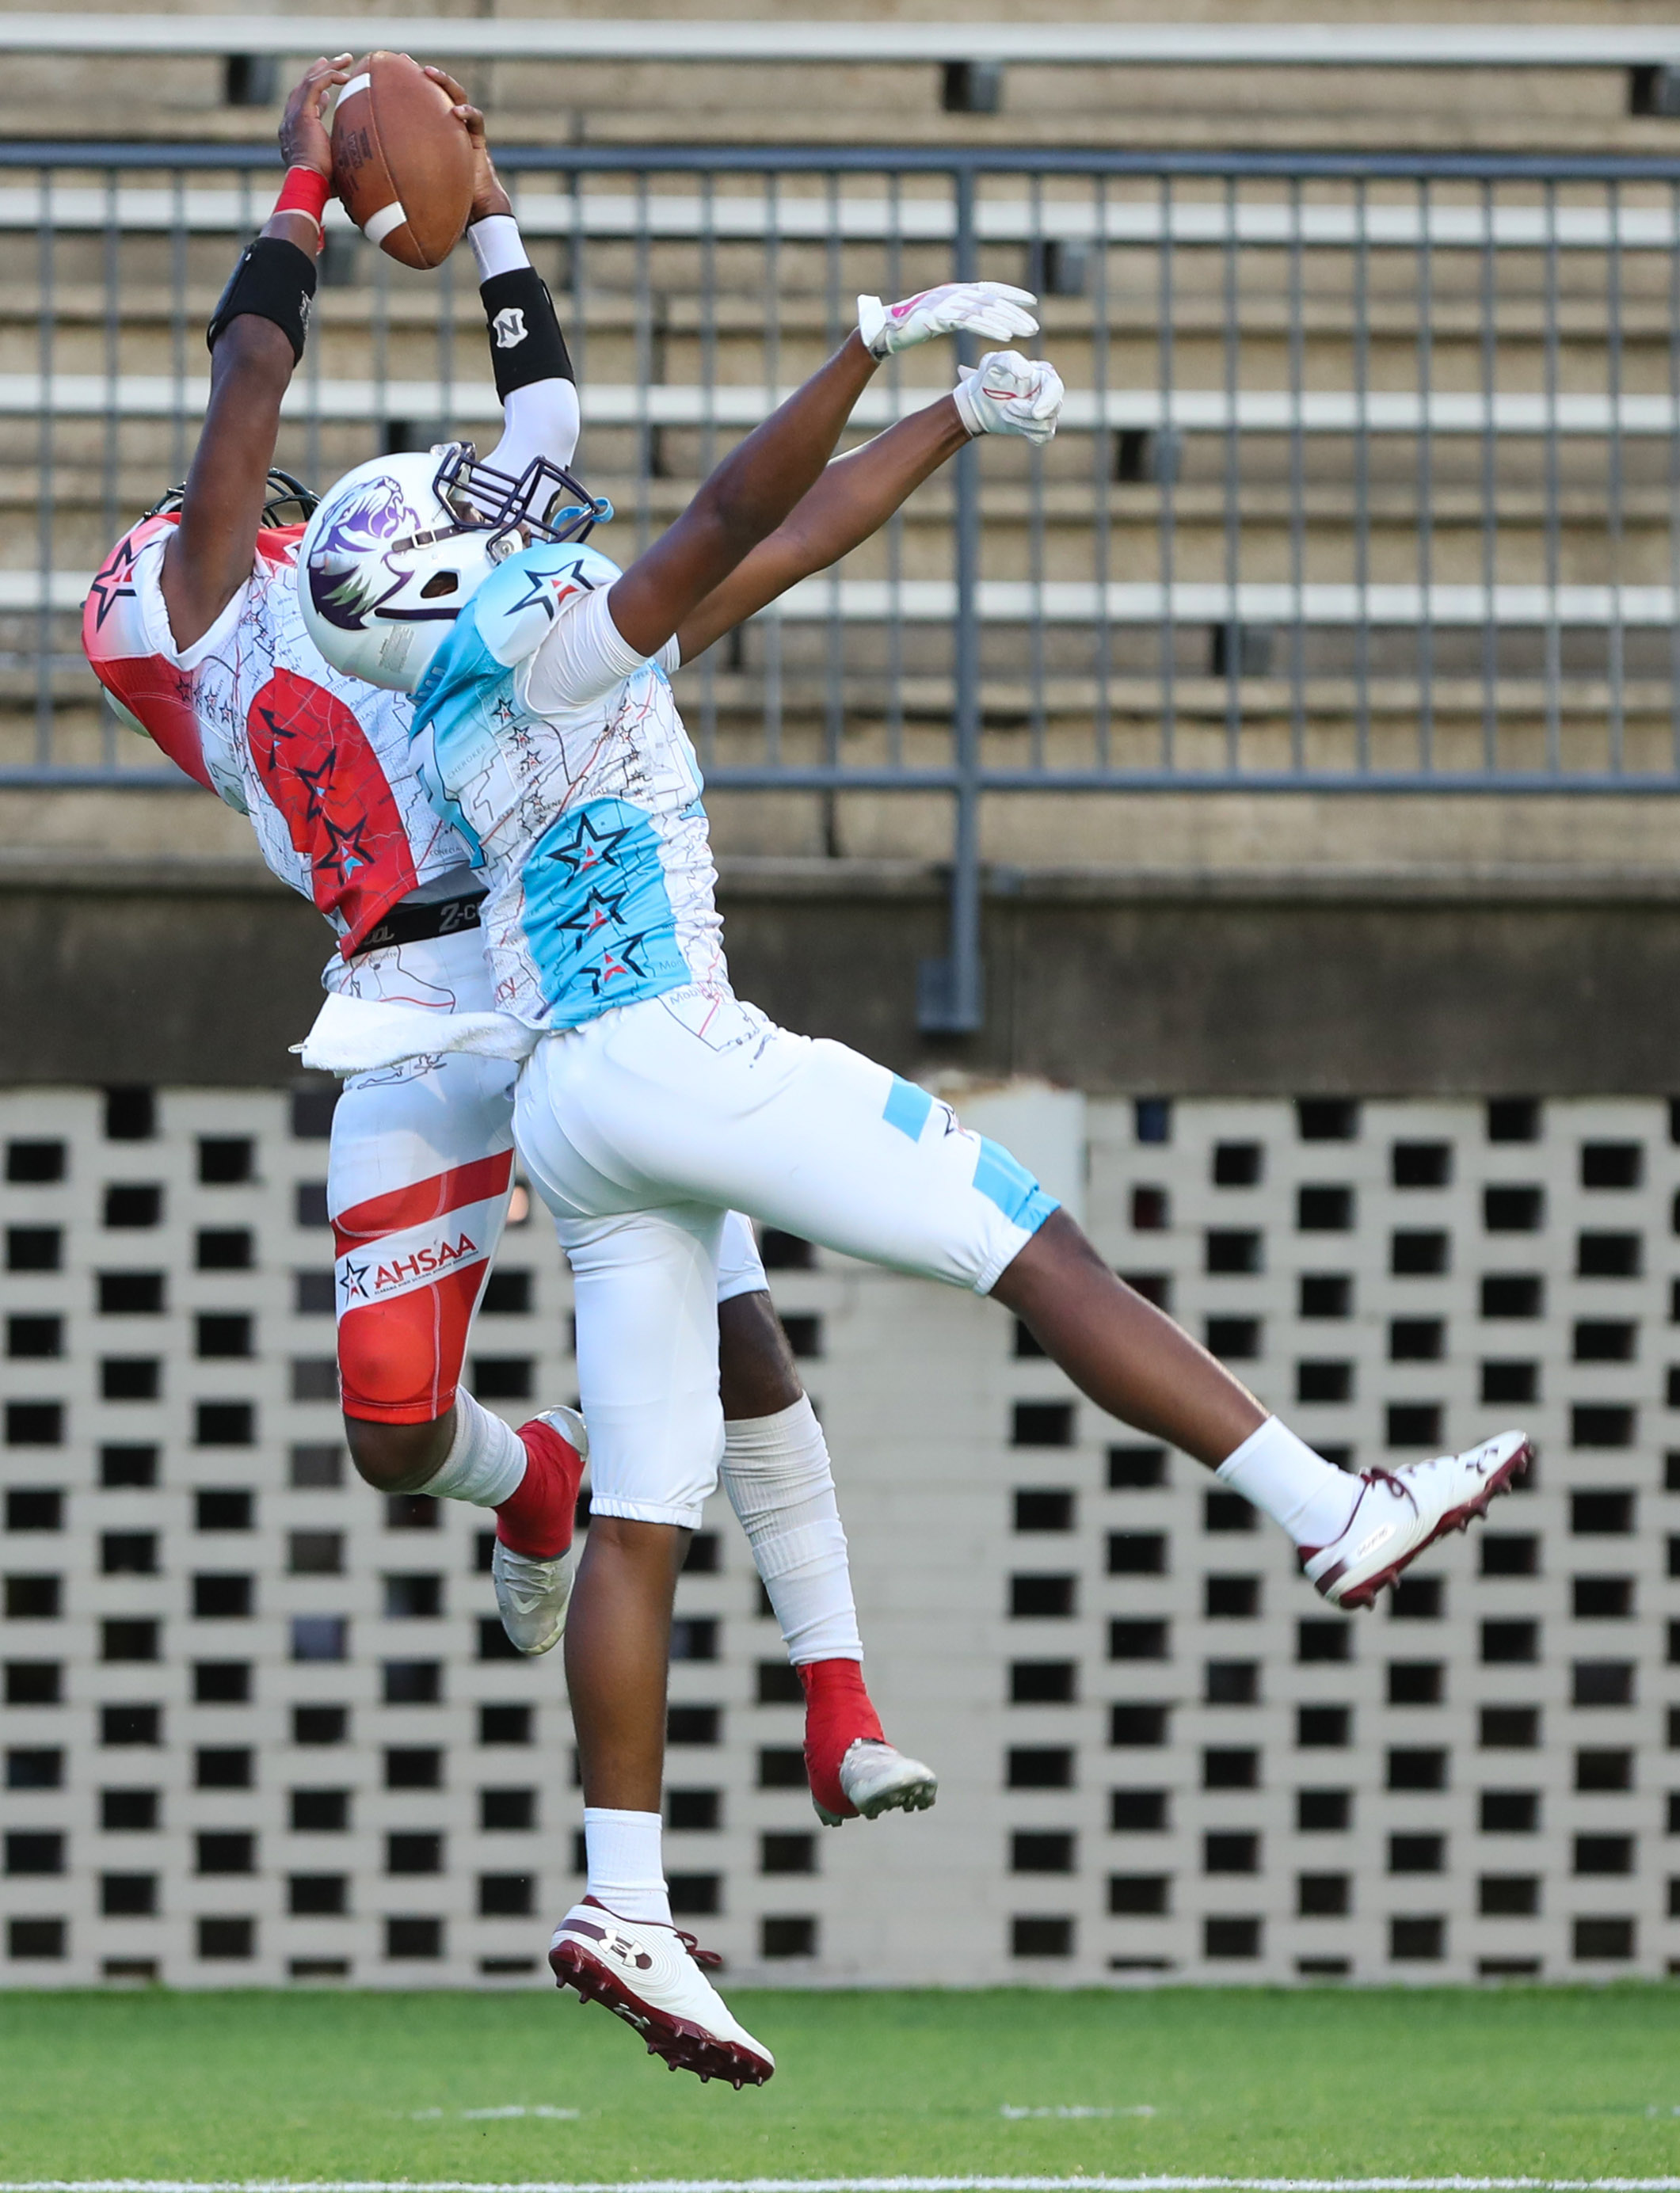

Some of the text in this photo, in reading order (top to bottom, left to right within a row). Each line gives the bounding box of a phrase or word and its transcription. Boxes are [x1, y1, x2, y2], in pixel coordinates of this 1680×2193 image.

[497, 314, 520, 344] N
[448, 744, 486, 779] CHEROKEE
[440, 902, 481, 933] Z-C
[374, 1232, 477, 1290] AHSAA
